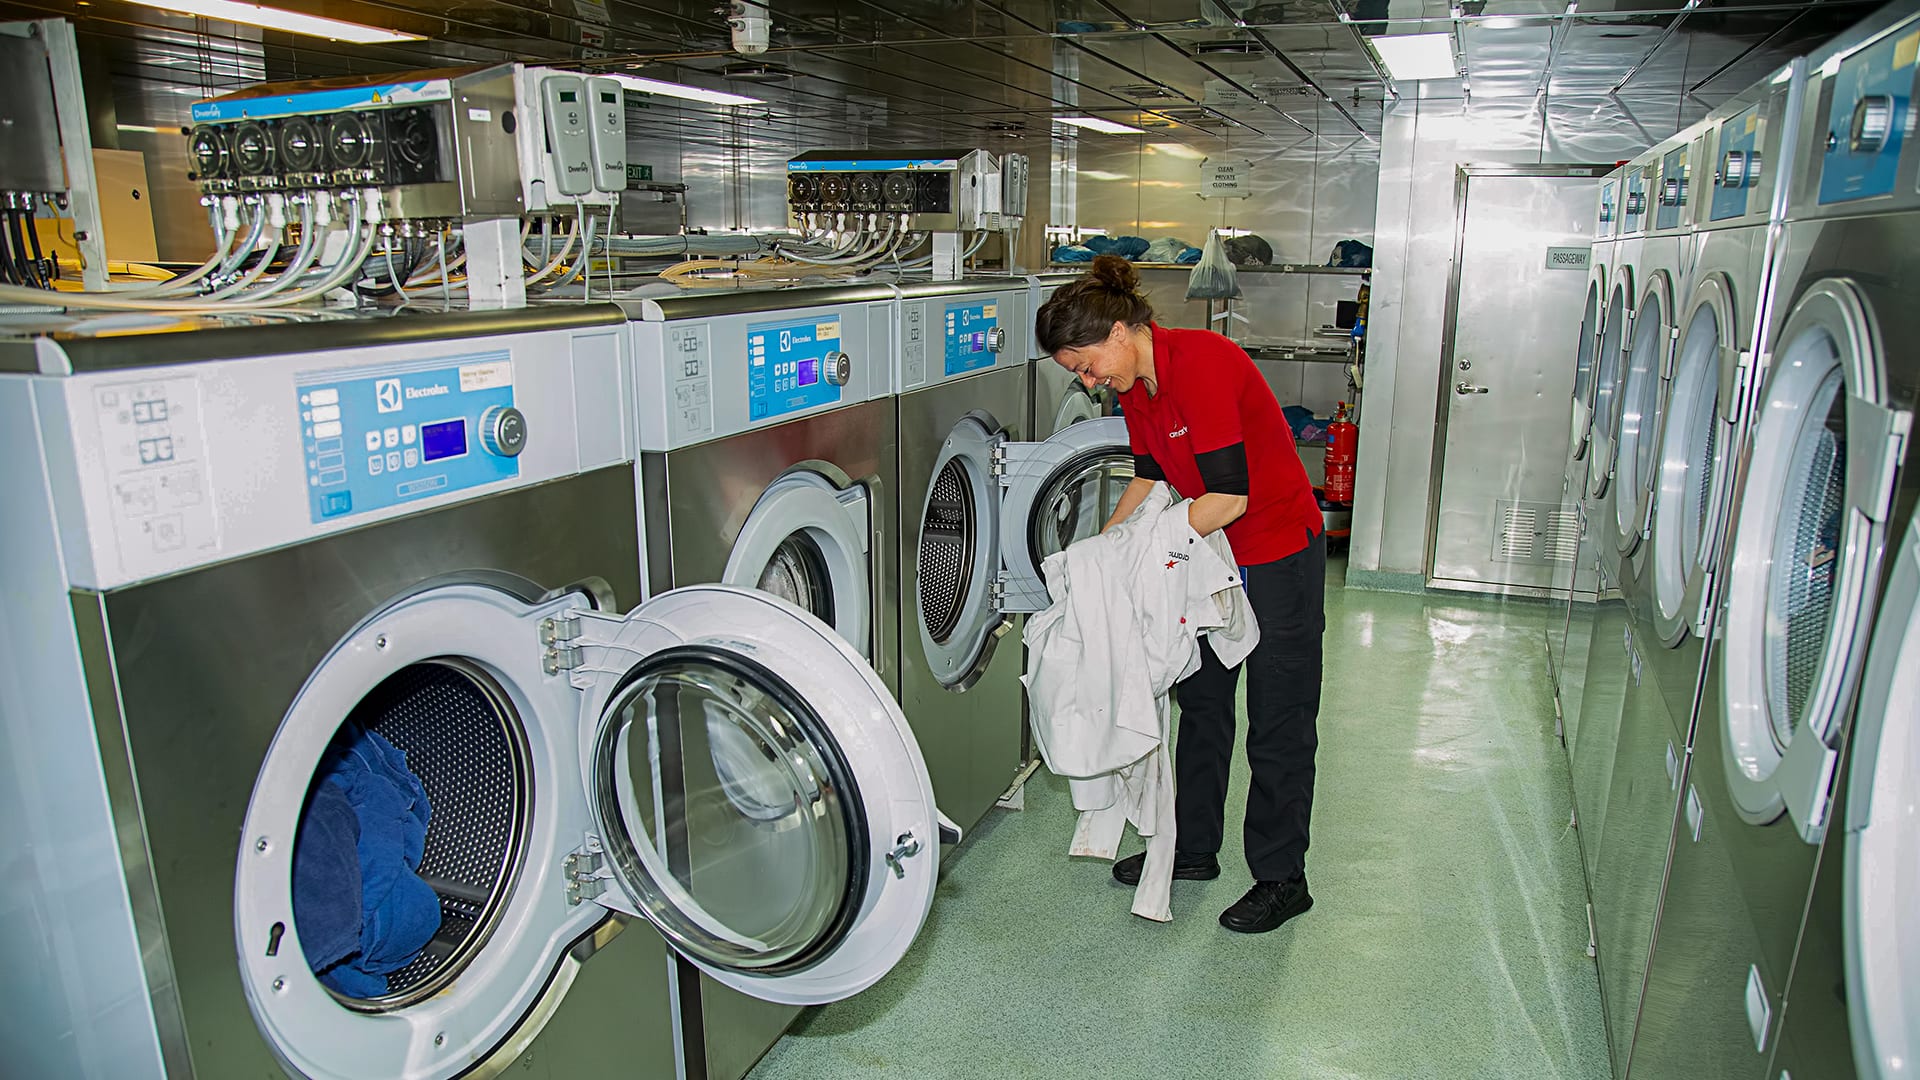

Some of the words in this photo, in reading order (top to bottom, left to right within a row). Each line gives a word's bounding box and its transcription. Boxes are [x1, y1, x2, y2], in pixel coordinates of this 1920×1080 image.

[568, 162, 588, 173] Diversey
[605, 161, 624, 172] Diversey
[627, 167, 643, 179] EXIT
[1552, 252, 1587, 264] PASSAGEWAY
[405, 384, 449, 399] Electrolux
